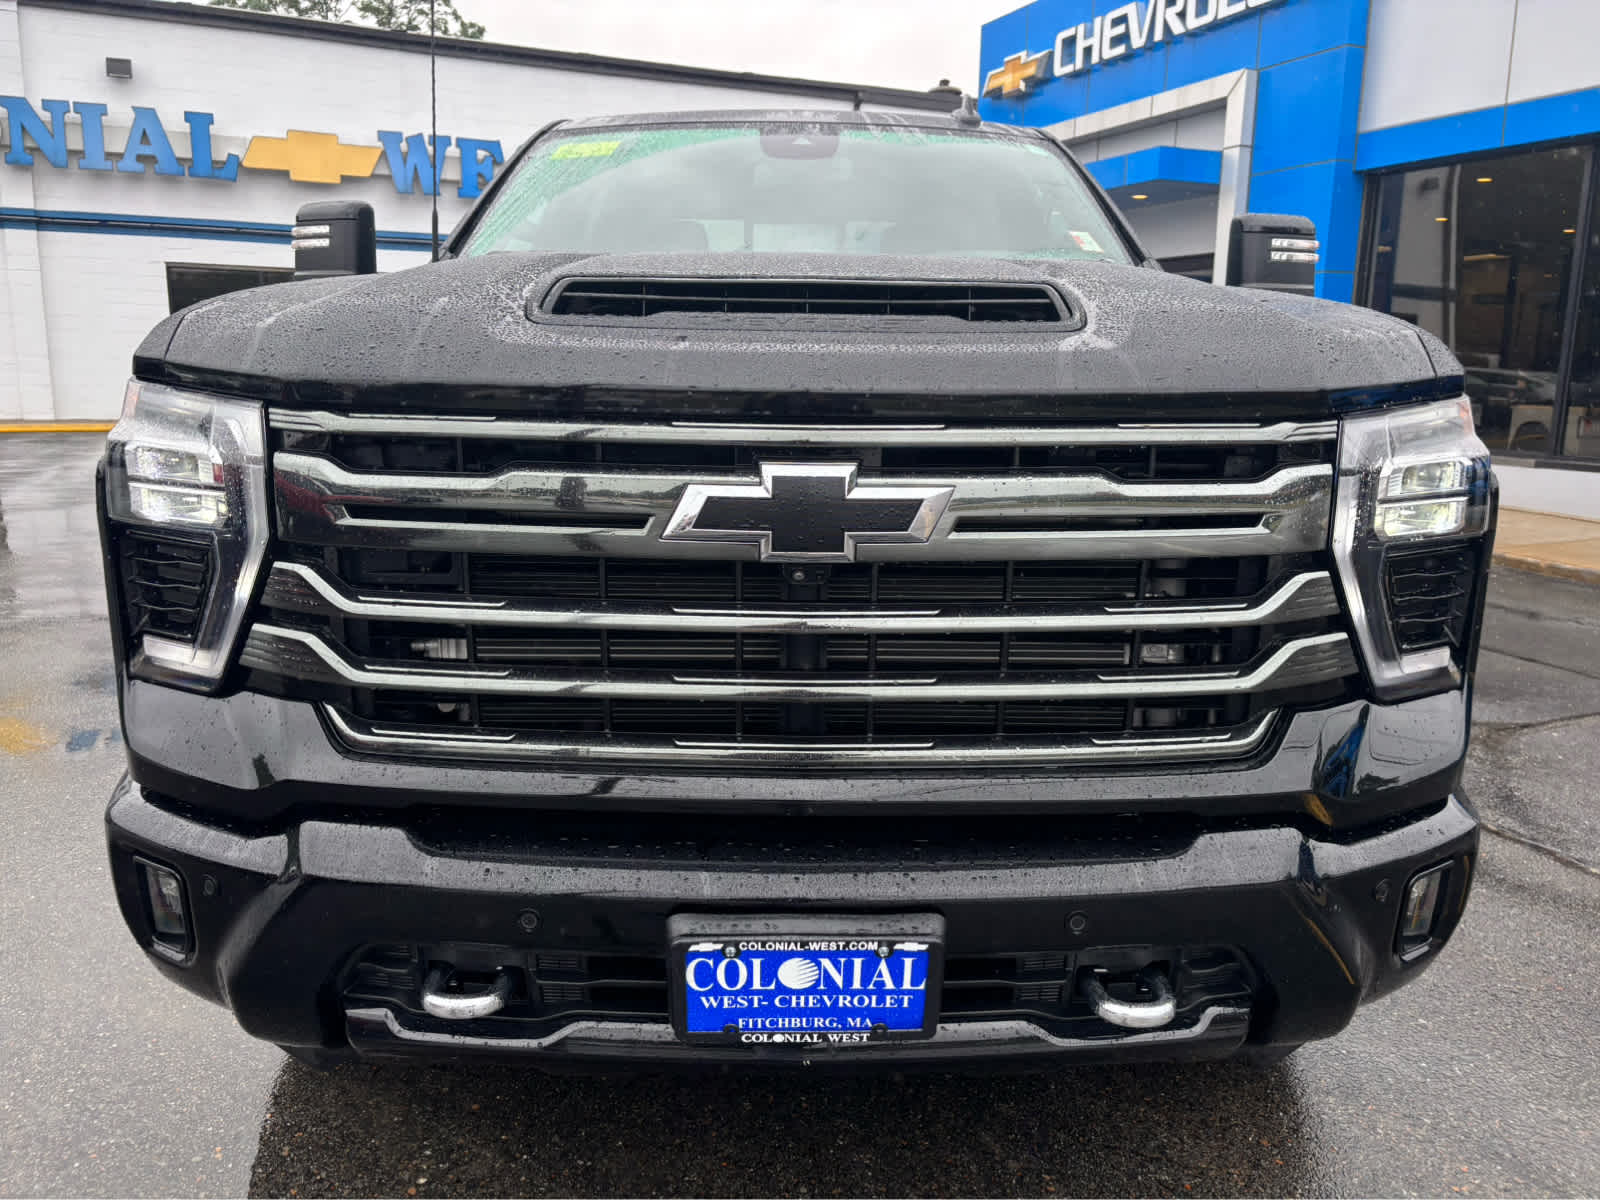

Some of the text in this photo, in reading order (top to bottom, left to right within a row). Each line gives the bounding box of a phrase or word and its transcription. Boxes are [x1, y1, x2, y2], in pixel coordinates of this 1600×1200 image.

[1053, 0, 1274, 77] CHEVROL
[0, 95, 239, 182] NIAL
[739, 941, 879, 951] COLONIAL-WEST.COM
[685, 957, 927, 992] COLONIAL
[700, 994, 914, 1009] WEST- CHEVROLET
[738, 1017, 873, 1029] FITCHBURG, MA
[741, 1033, 870, 1043] COLONIAL WEST
